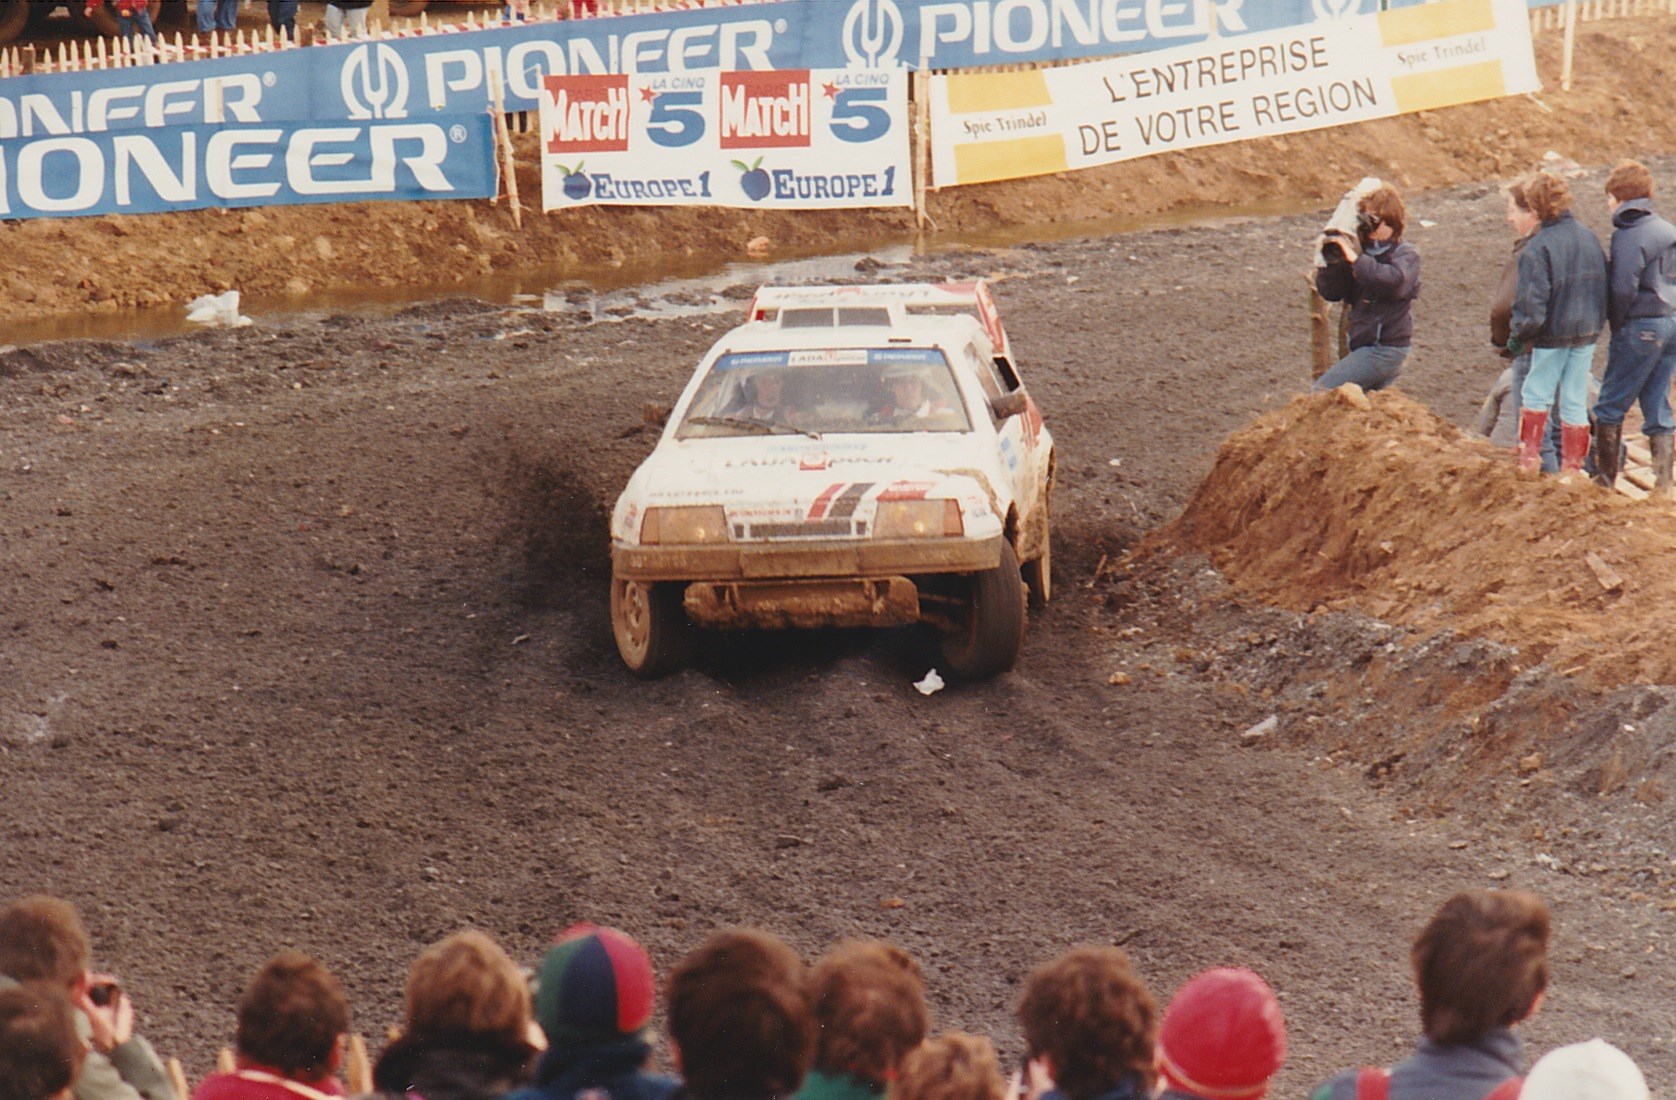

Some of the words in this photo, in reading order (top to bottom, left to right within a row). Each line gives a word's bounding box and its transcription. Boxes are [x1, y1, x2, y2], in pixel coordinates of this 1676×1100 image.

[920, 0, 1248, 58] PIONEER
[425, 19, 775, 108] PIONEER
[652, 78, 667, 90] LA
[671, 77, 706, 89] CINQ
[836, 74, 850, 86] LA
[855, 73, 890, 85] CINQ
[1103, 36, 1329, 103] L'ENTREPRISE
[0, 72, 262, 138] NEER
[646, 91, 706, 148] 5
[829, 87, 892, 143] 5
[996, 110, 1047, 131] Trindel
[1078, 120, 1121, 155] DE
[1135, 101, 1240, 146] VOTRE
[1254, 76, 1378, 126] REGION
